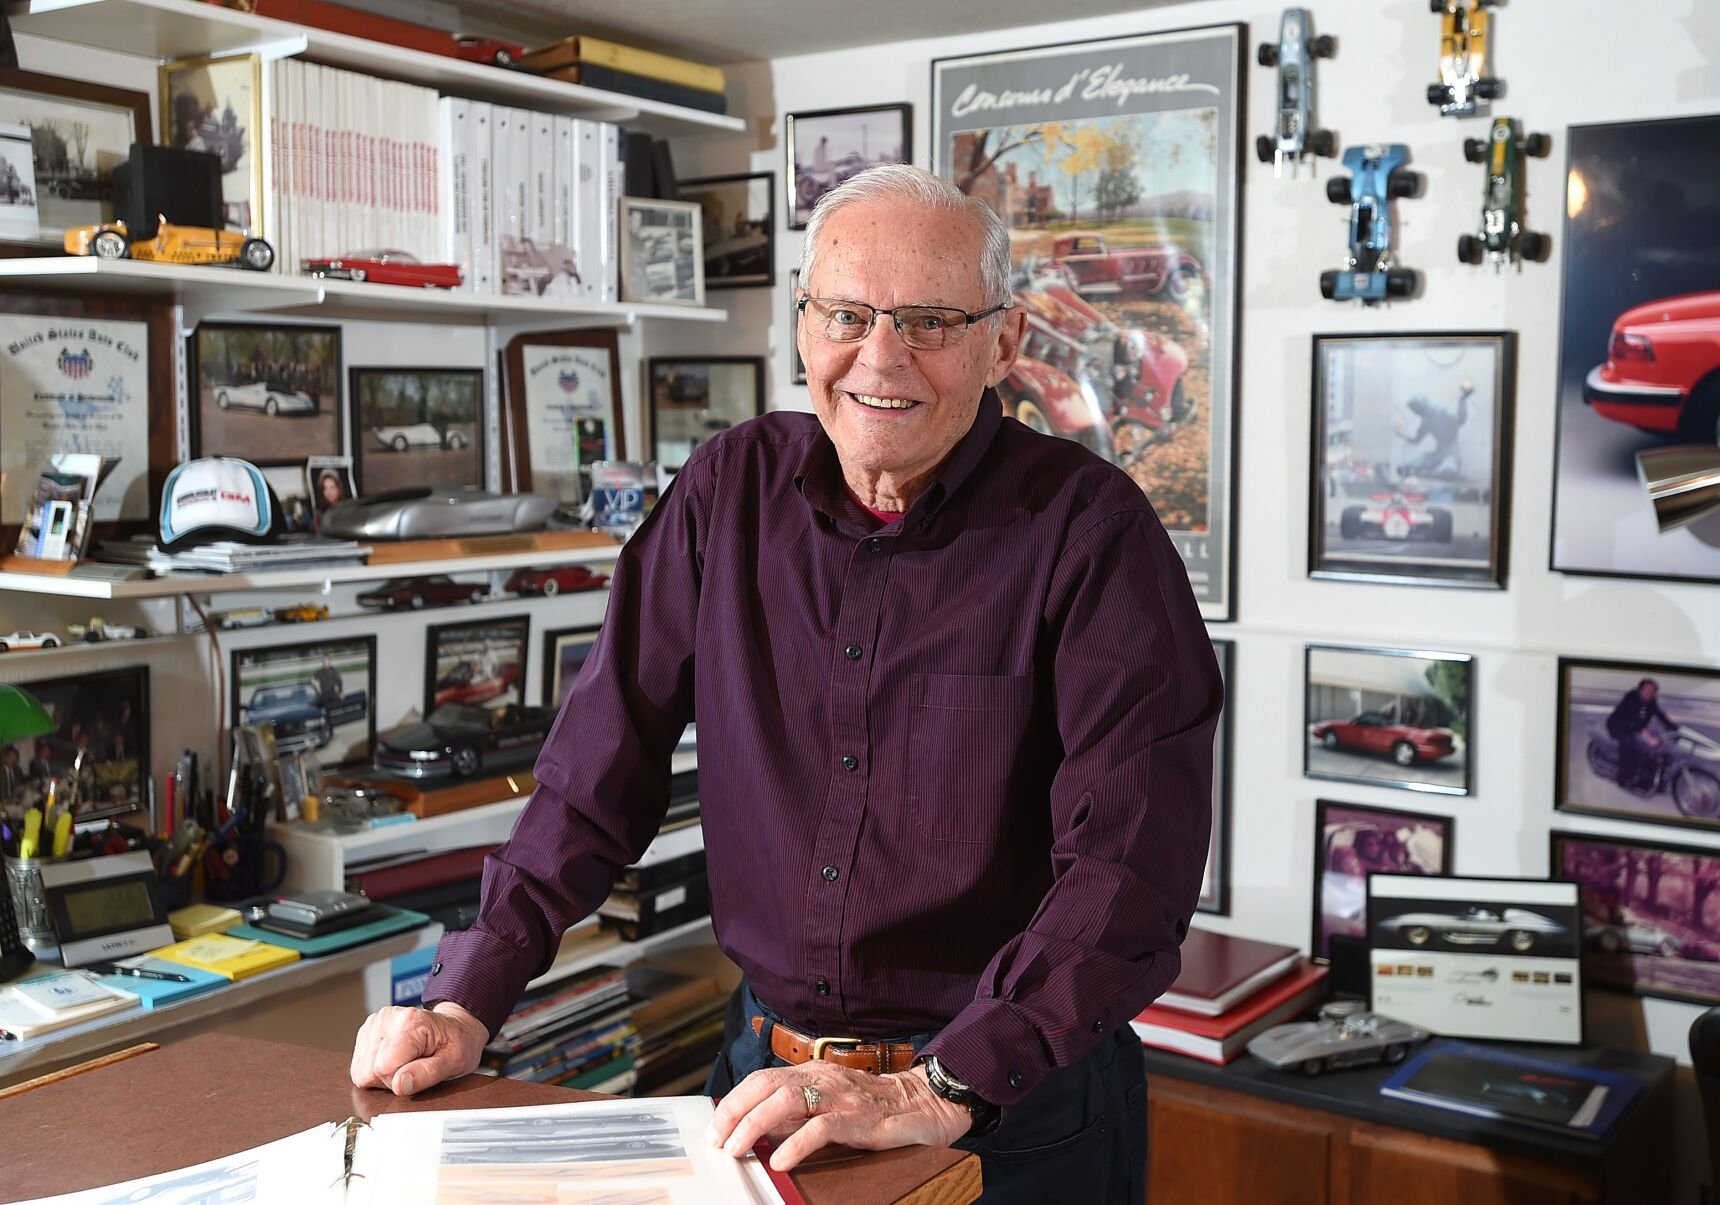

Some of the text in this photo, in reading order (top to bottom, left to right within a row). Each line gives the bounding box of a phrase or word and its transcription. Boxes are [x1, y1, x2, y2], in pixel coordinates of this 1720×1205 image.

[1053, 63, 1220, 106] d'Elegance
[8, 327, 140, 362] United States Auto Club
